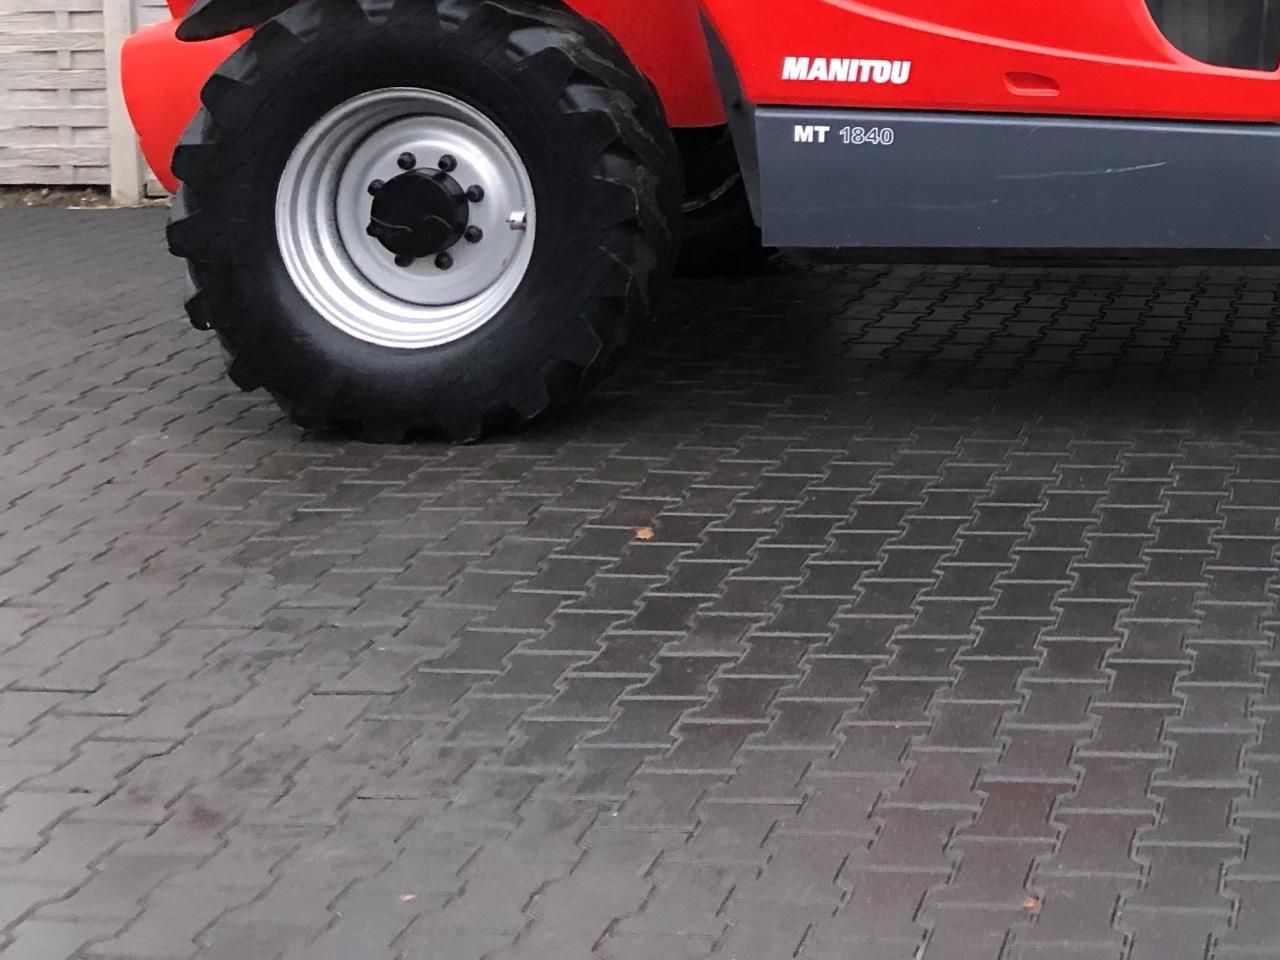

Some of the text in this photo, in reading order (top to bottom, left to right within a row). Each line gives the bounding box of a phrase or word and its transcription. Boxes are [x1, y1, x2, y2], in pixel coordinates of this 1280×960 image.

[782, 56, 911, 85] MANITOU
[794, 125, 894, 145] MT 1840
